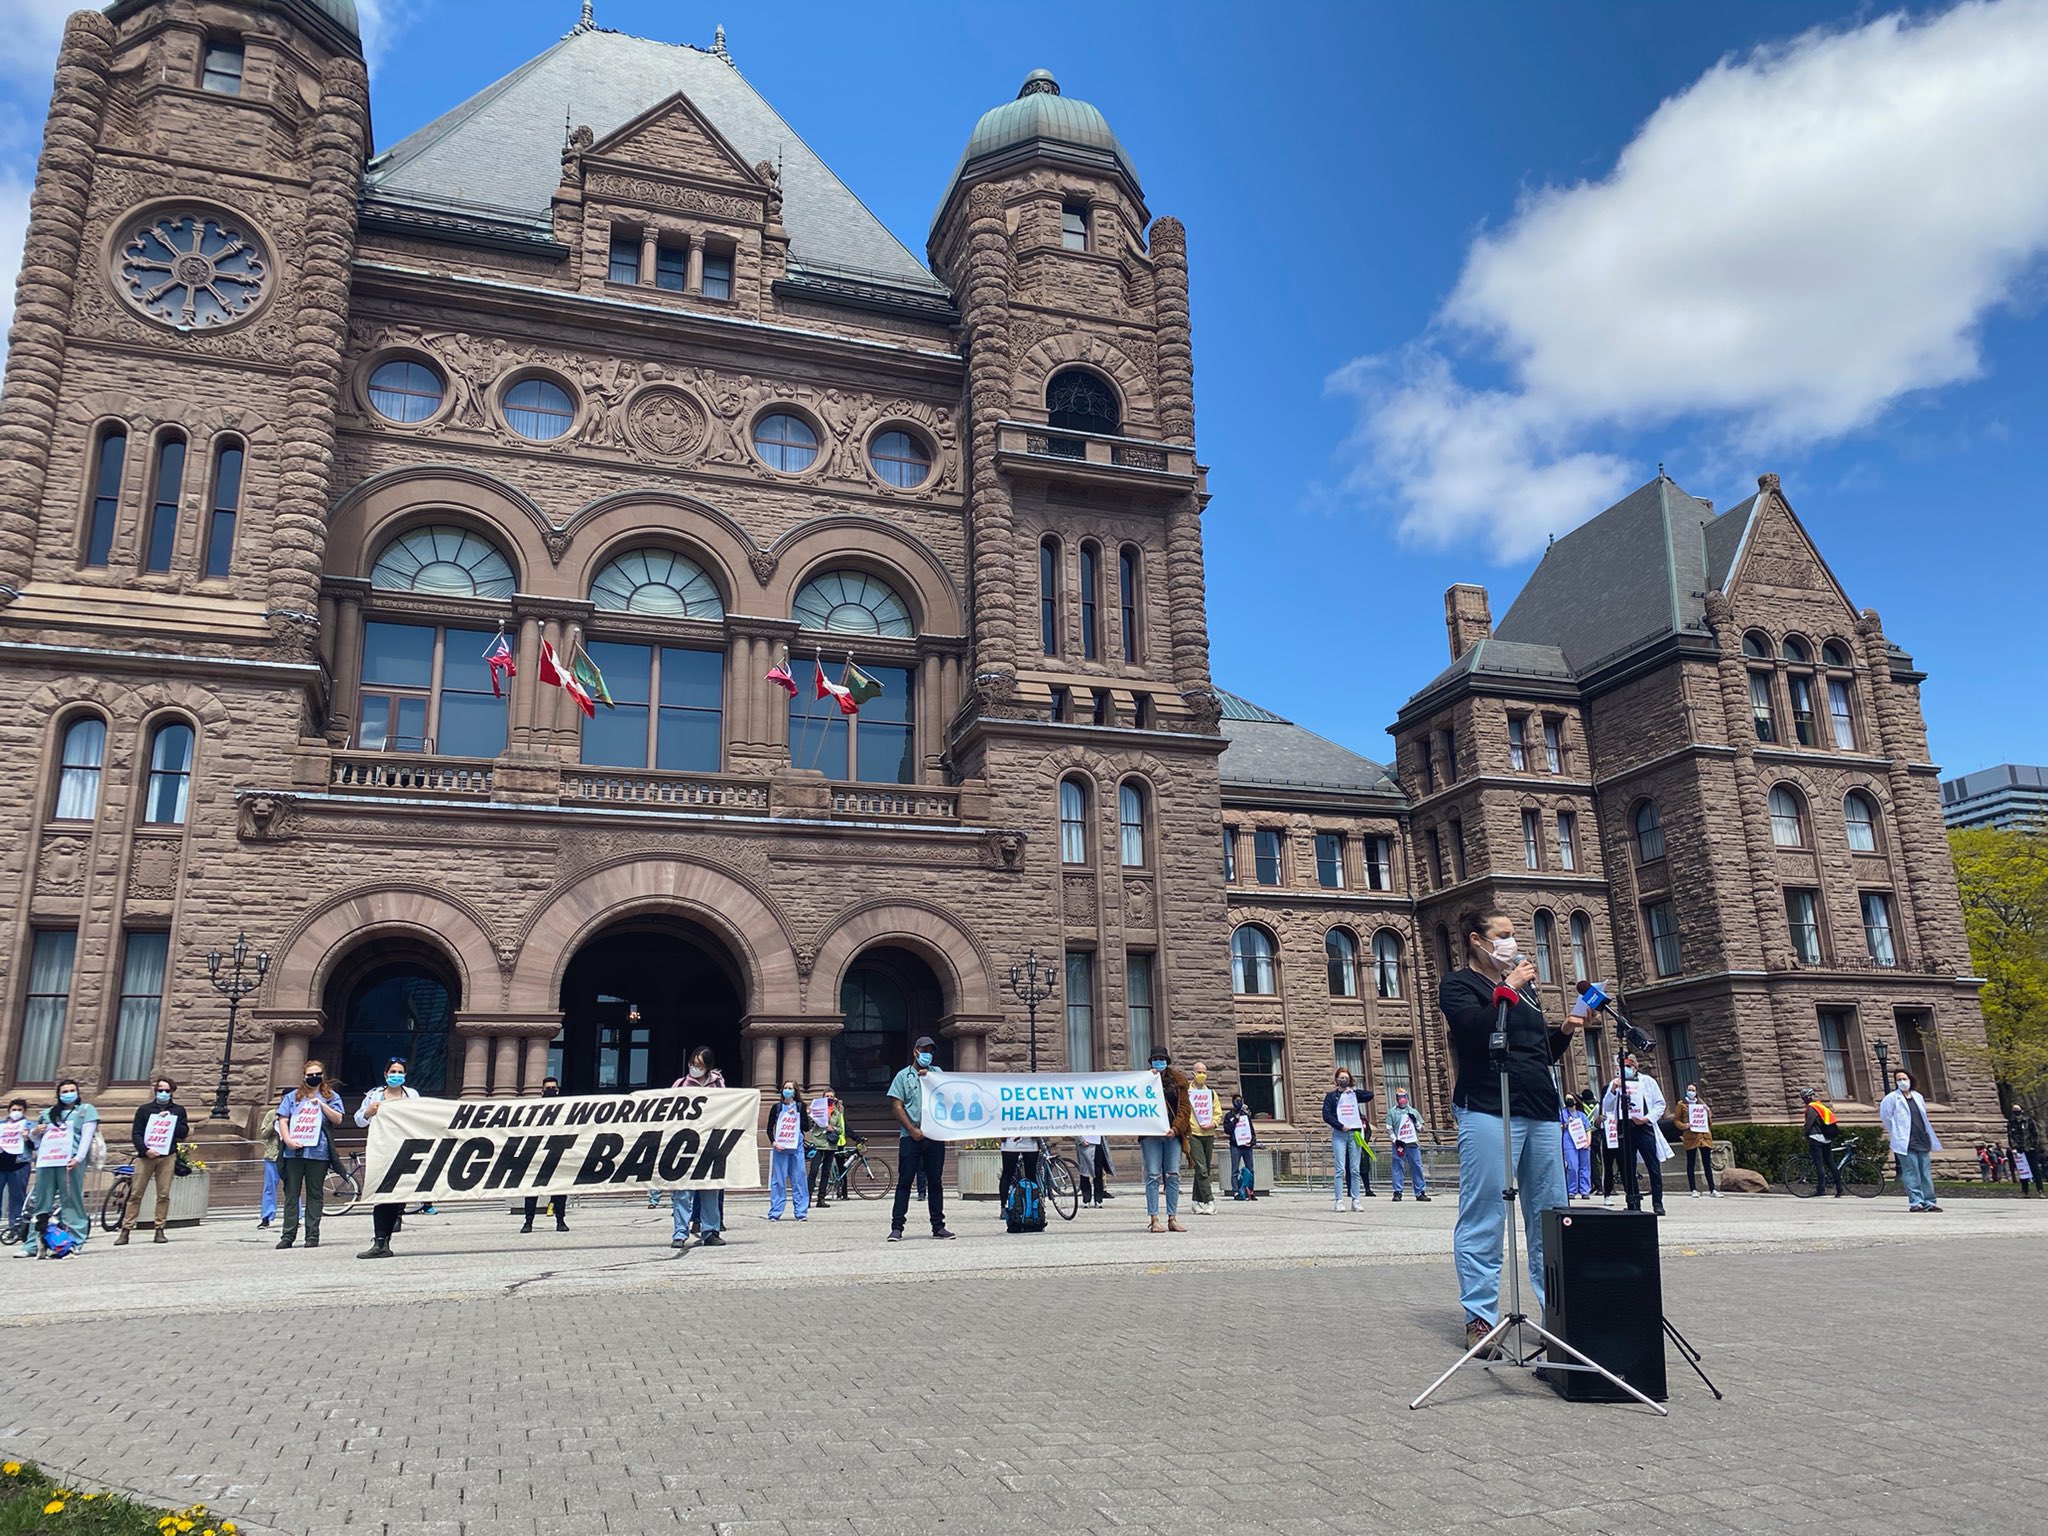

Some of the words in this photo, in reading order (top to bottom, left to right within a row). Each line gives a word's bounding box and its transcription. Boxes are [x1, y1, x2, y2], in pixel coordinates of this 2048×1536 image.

[1000, 1086, 1075, 1101] DECENT
[1082, 1084, 1139, 1100] WORK
[1145, 1085, 1157, 1099] &
[299, 1107, 319, 1115] PAID
[448, 1104, 564, 1130] HEALTH
[564, 1096, 708, 1125] WORKERS
[1001, 1105, 1068, 1121] HEALTH
[1074, 1103, 1160, 1119] NETWORK
[1001, 1124, 1096, 1132] www.decentworkandhealth.org
[375, 1134, 579, 1194] FIGHT
[573, 1128, 746, 1186] BACK
